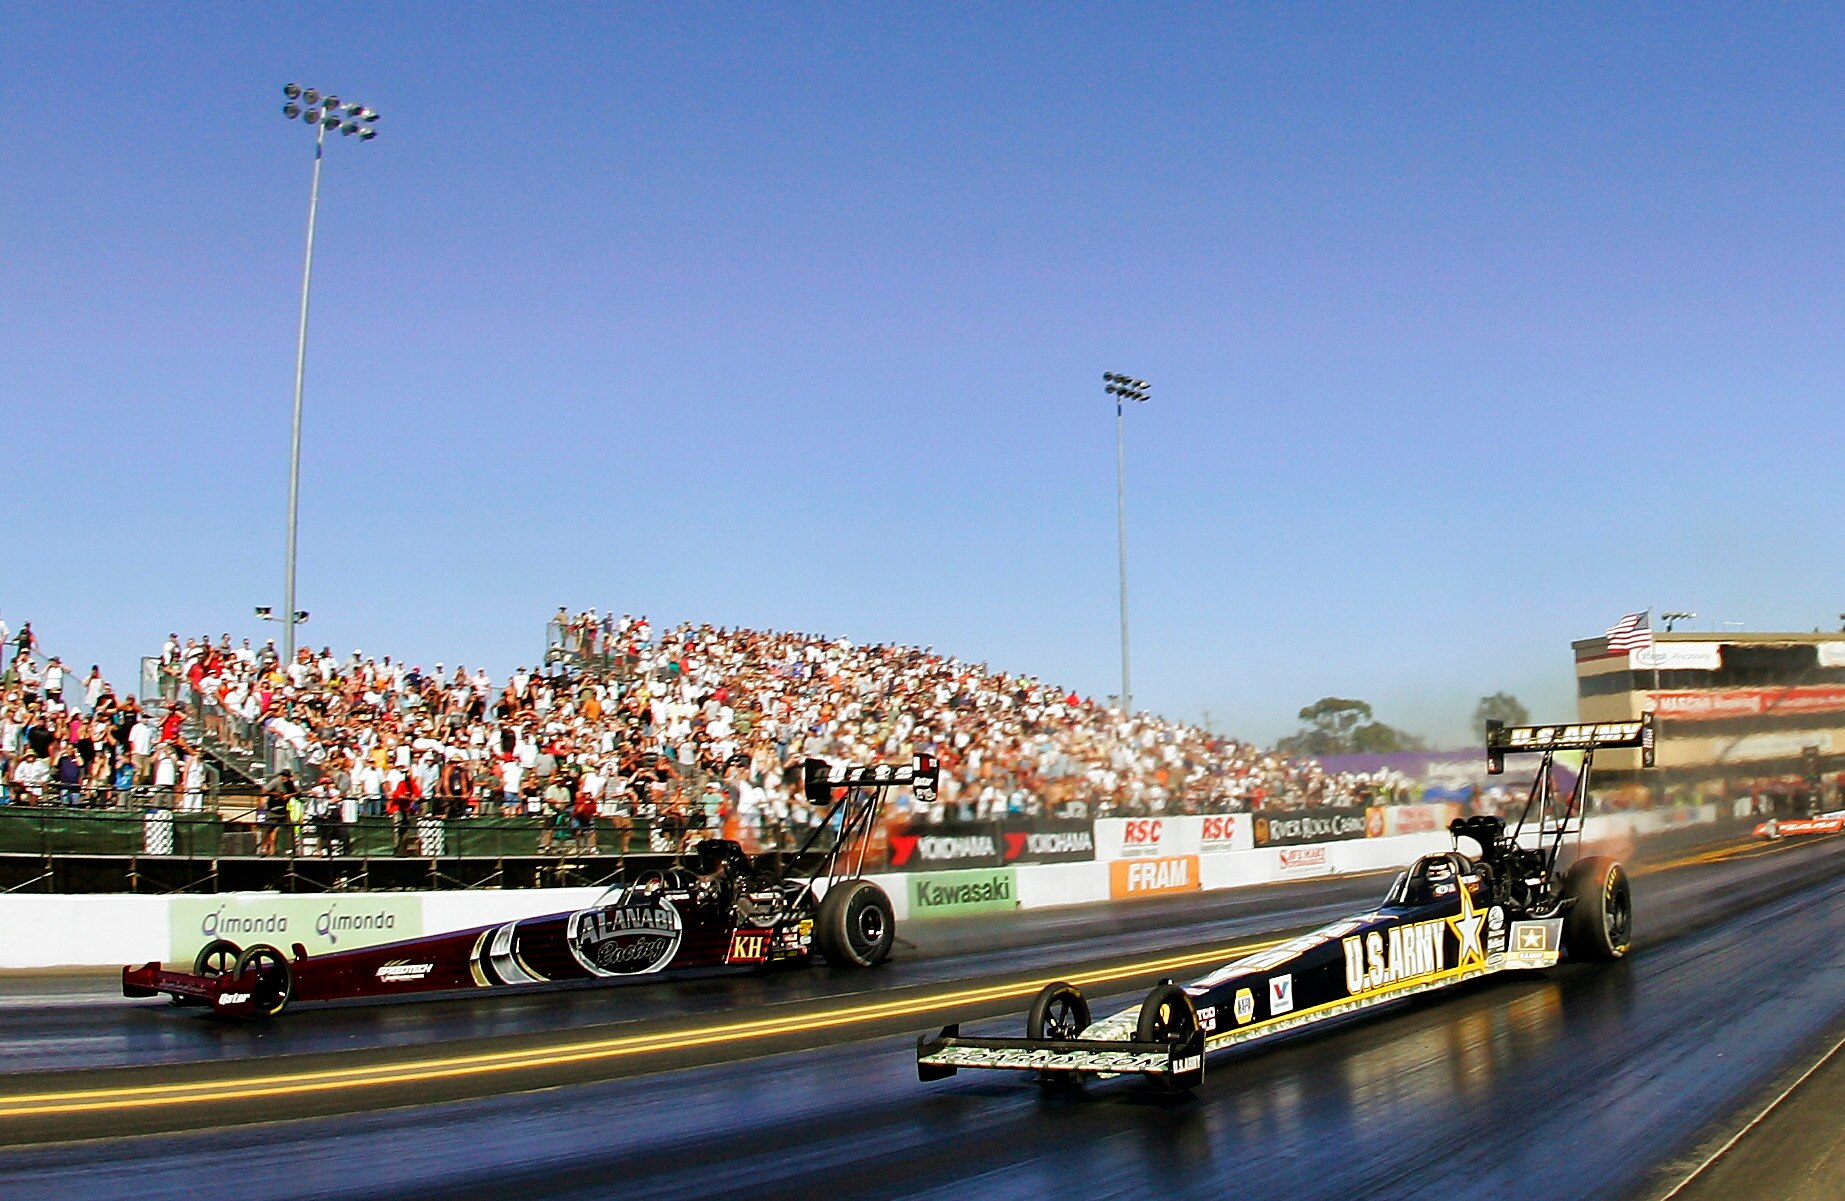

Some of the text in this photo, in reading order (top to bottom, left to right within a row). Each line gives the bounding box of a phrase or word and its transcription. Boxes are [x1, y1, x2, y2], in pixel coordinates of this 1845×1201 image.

[1124, 819, 1162, 844] RSC
[1202, 817, 1235, 840] RSC
[917, 835, 996, 860] YOKOHAMA
[1026, 831, 1094, 854] YOKOHAMA
[1127, 859, 1190, 892] FRAM
[916, 875, 1010, 908] Kawasaki
[597, 937, 666, 968] Racing
[732, 936, 764, 958] KH
